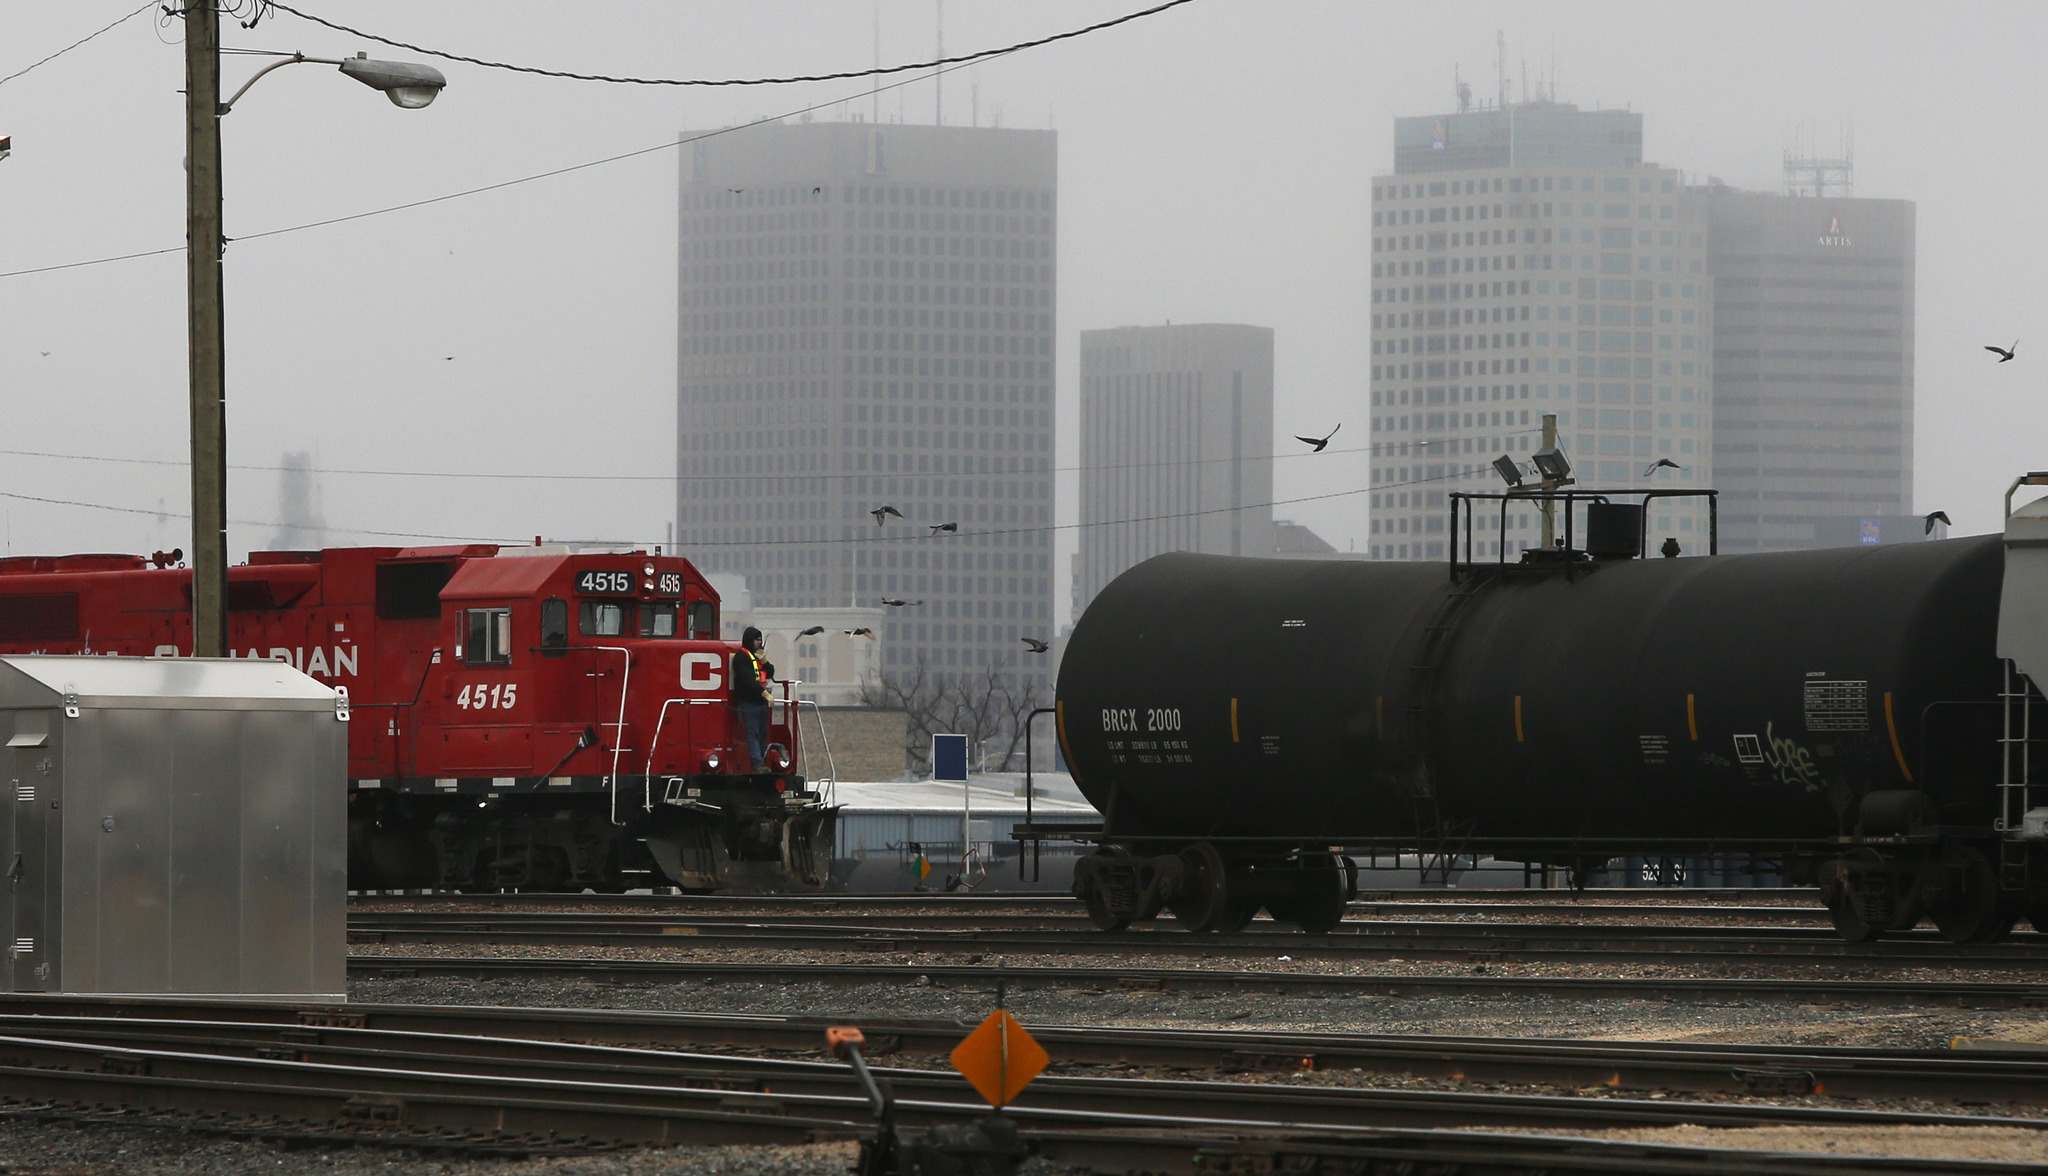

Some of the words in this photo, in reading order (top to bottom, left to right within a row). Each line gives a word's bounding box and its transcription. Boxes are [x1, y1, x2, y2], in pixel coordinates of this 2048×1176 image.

[581, 572, 629, 591] 4515
[660, 574, 680, 592] 4515
[457, 684, 517, 709] 4515
[1102, 708, 1138, 731] BRCX
[1147, 708, 1181, 731] 2000
